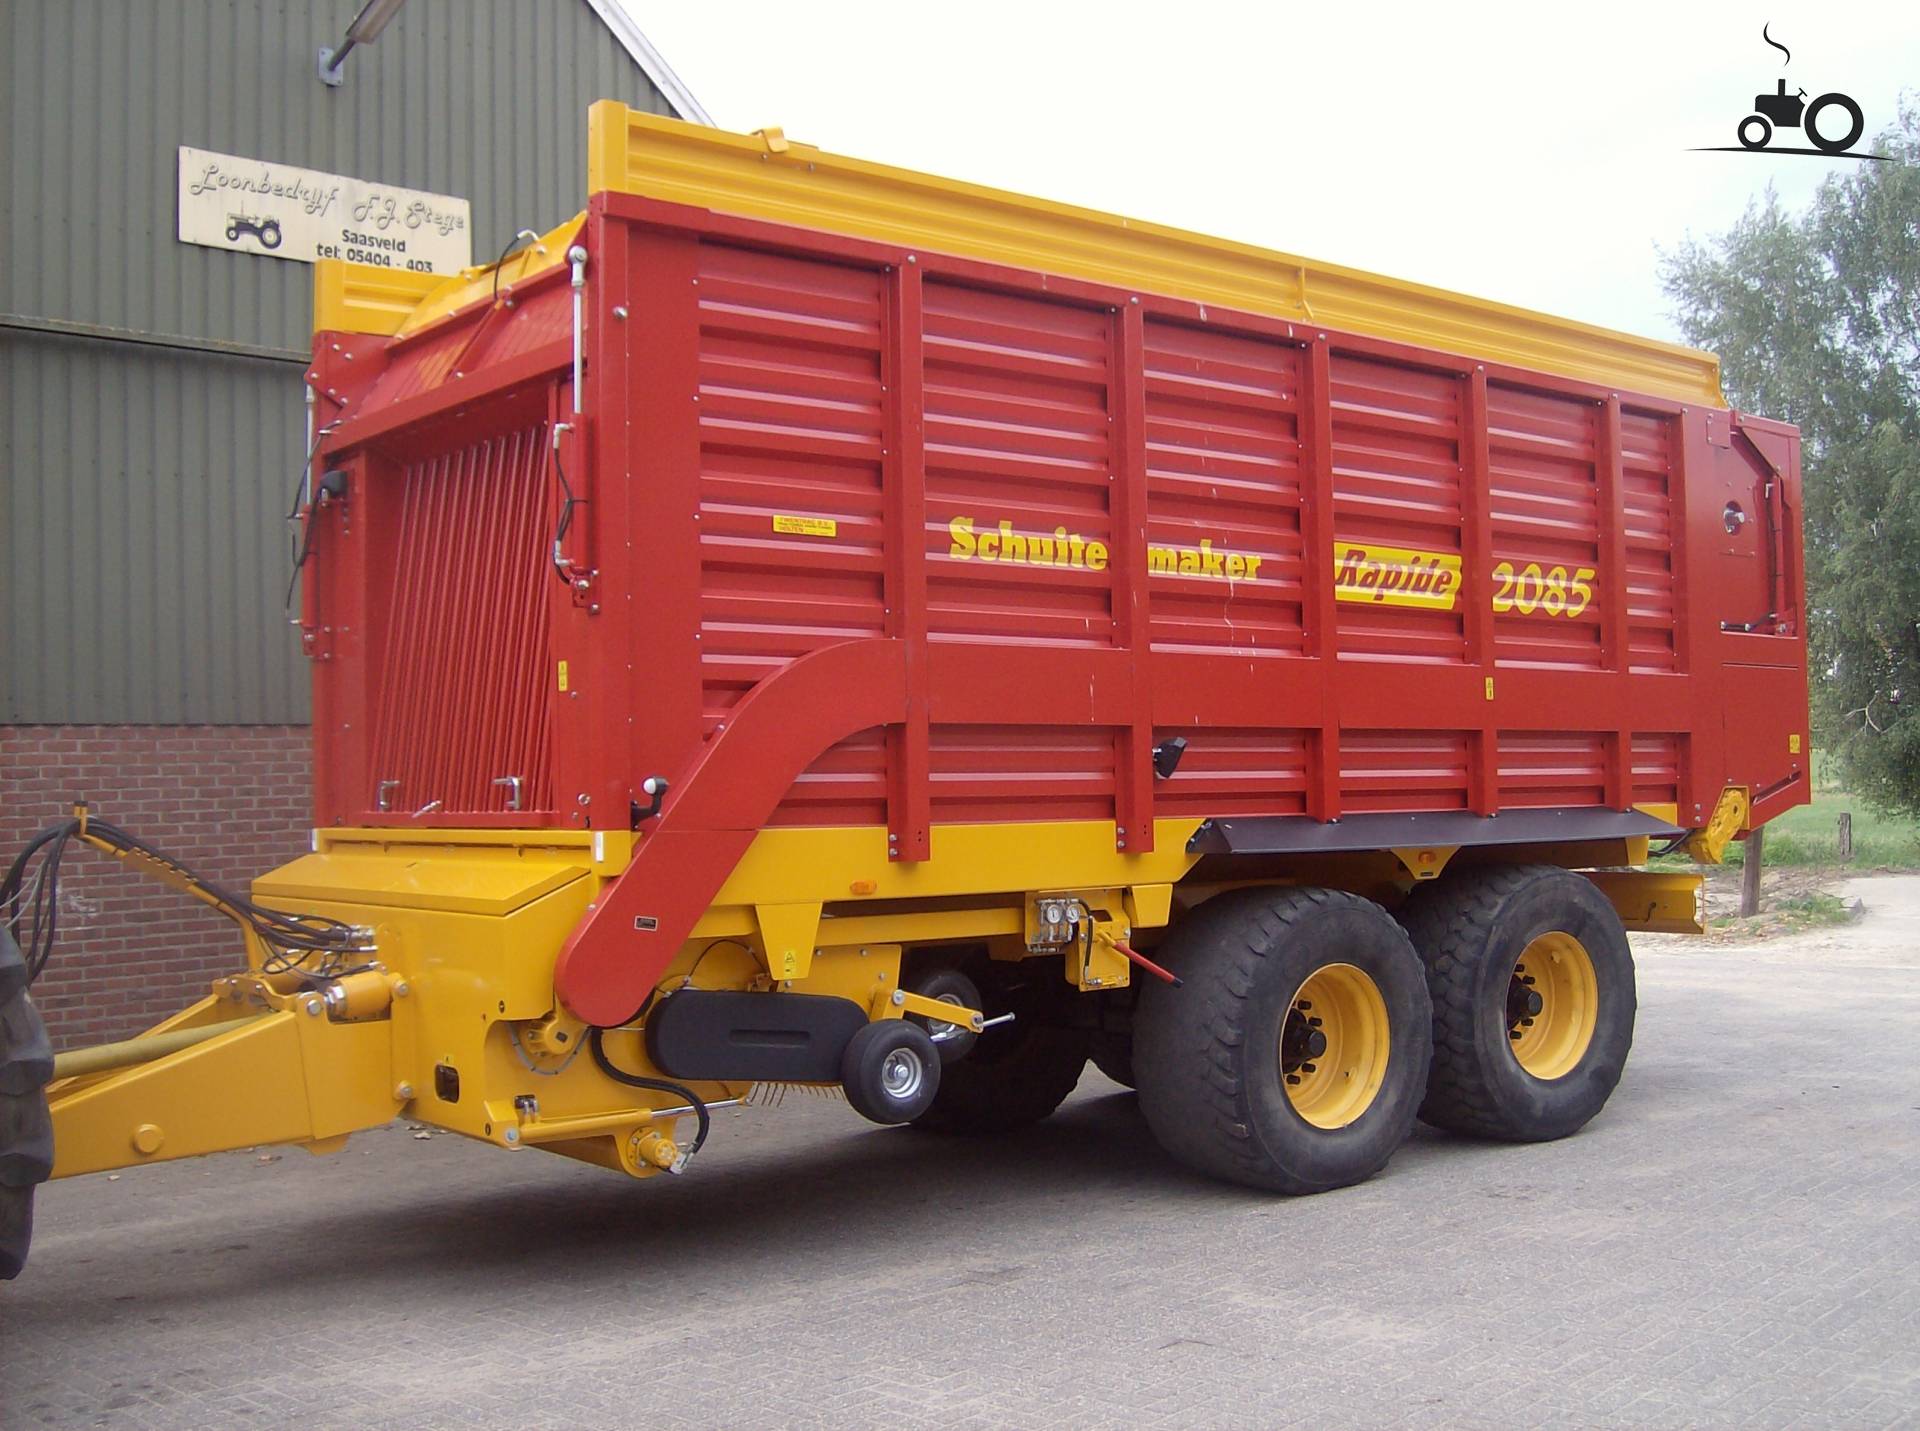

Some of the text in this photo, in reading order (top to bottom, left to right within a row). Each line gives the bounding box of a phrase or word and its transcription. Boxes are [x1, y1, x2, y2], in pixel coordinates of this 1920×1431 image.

[341, 229, 406, 252] Saasveld
[346, 248, 391, 267] 05404
[406, 258, 433, 273] 403
[949, 516, 1596, 618] Schuite maker Rapide 2085
